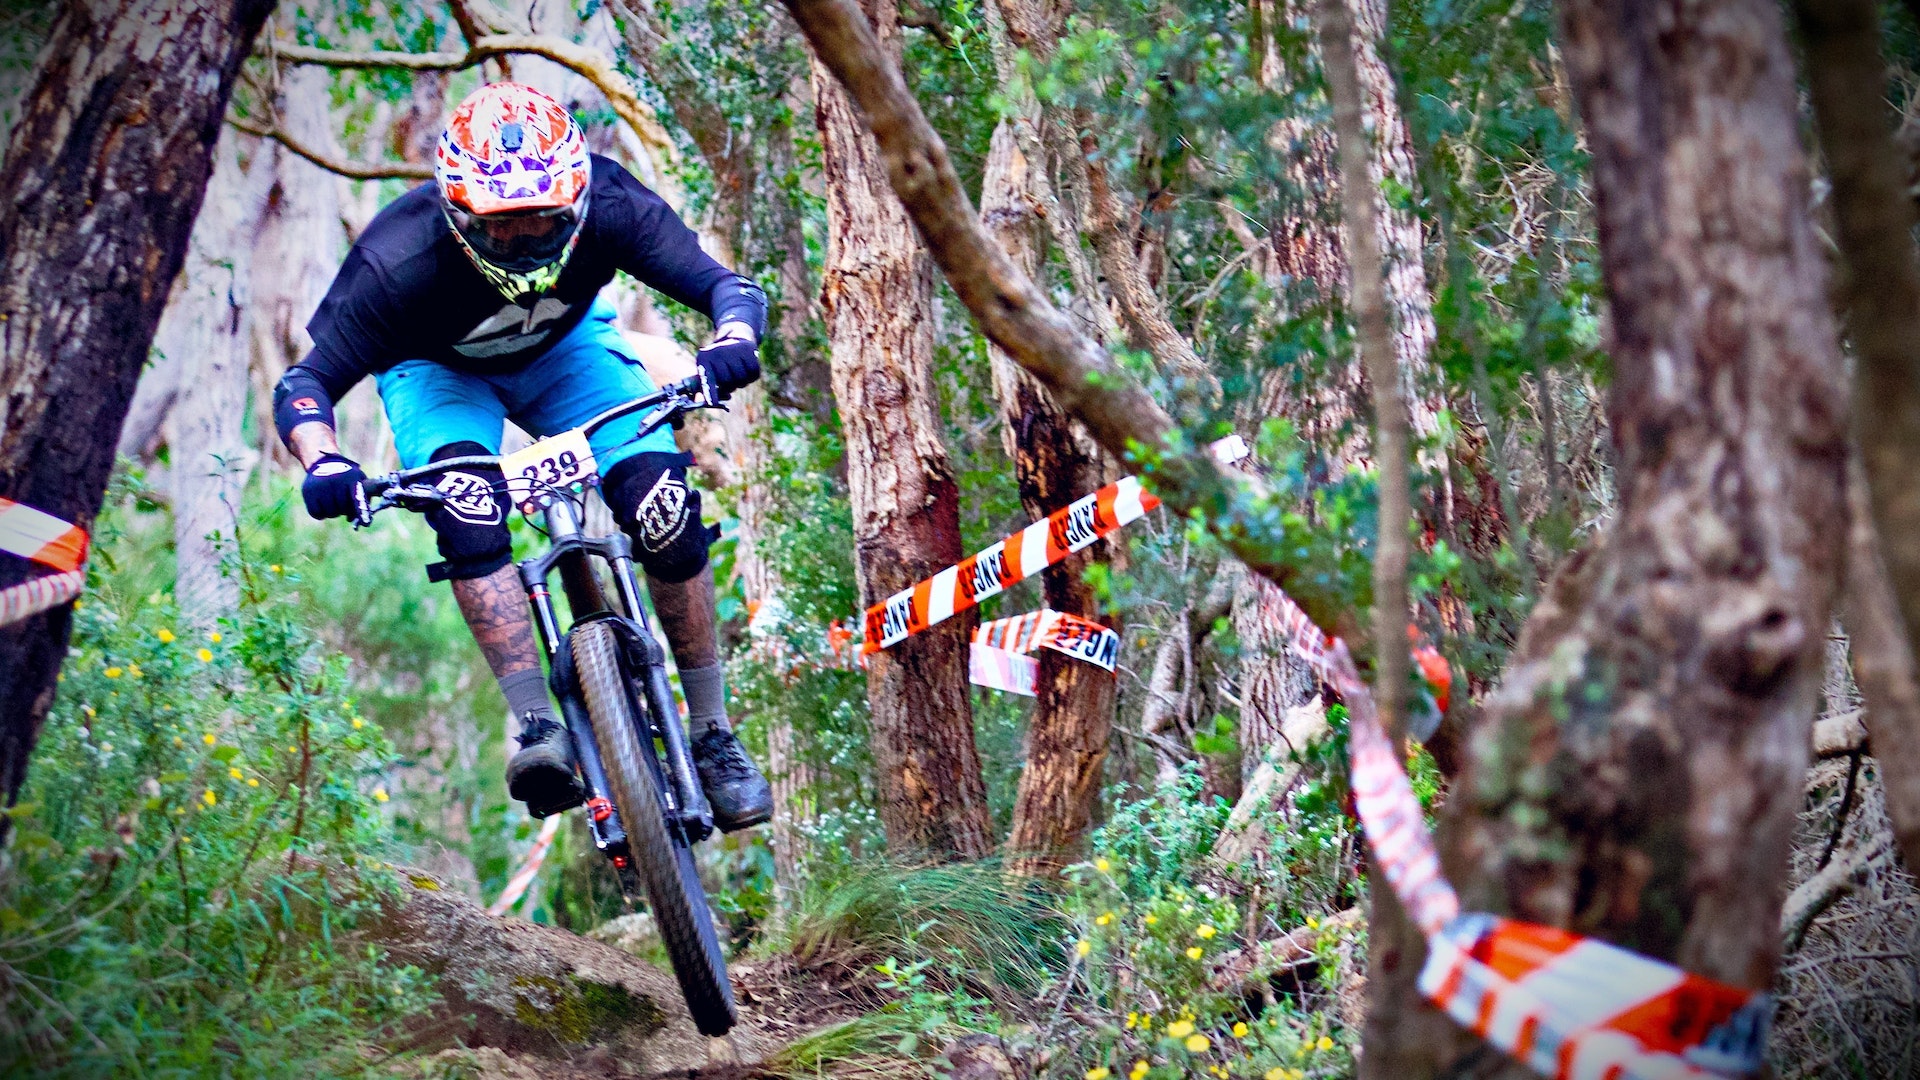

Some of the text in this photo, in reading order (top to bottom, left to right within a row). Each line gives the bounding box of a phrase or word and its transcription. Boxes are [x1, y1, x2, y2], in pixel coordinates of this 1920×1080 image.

[522, 450, 579, 495] 239
[1052, 500, 1106, 550] DANGER
[958, 550, 1012, 598] DANGER
[865, 597, 918, 645] DANGER
